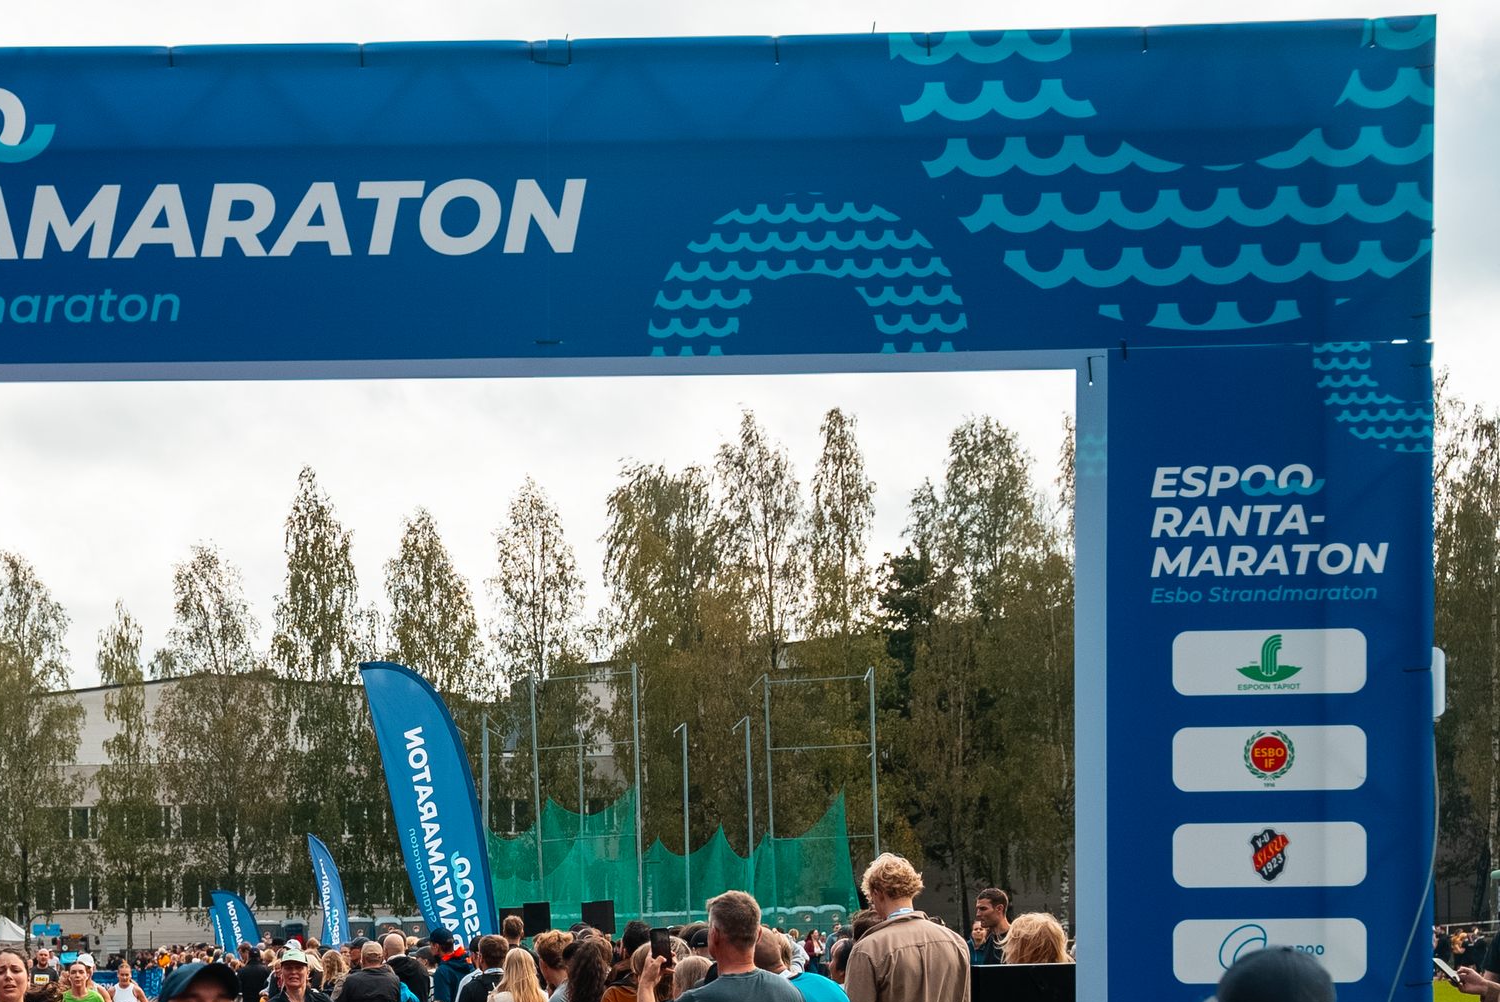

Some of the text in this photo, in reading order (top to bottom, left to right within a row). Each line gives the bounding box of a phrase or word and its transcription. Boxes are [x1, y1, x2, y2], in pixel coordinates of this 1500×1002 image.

[1150, 463, 1326, 499] ESPOO
[1150, 503, 1326, 538] RANTA-
[1150, 542, 1389, 578] MARATON
[1150, 584, 1378, 604] Esbo Strandmaraton
[1237, 683, 1271, 691] ESPOON
[1254, 747, 1285, 758] ESBO
[1264, 758, 1276, 768] IF
[1255, 832, 1270, 848] V-U
[1262, 853, 1284, 876] 1923
